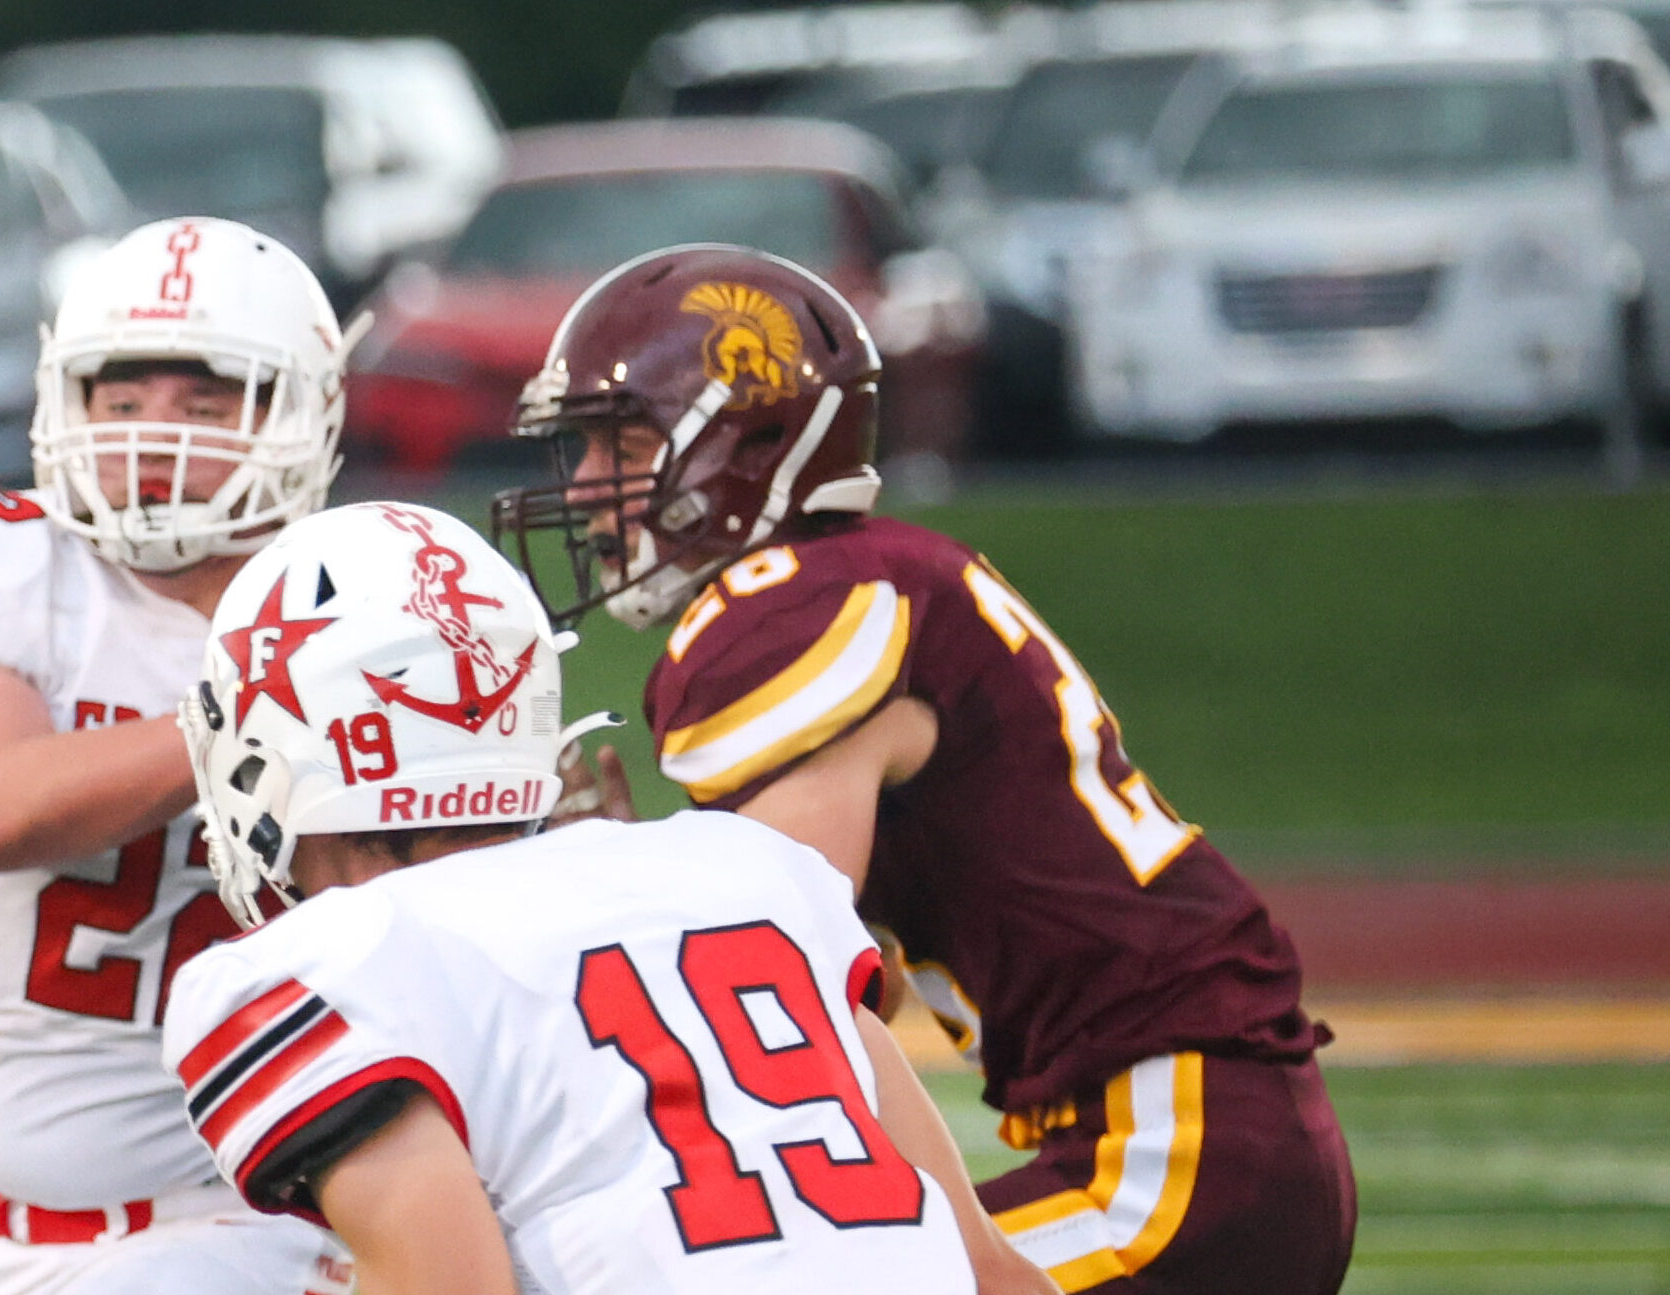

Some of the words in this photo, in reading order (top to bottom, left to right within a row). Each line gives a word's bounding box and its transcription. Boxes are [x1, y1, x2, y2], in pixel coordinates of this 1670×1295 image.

[248, 627, 282, 684] F
[328, 711, 399, 787] 19
[379, 780, 543, 824] Riddell
[577, 919, 926, 1253] 19
